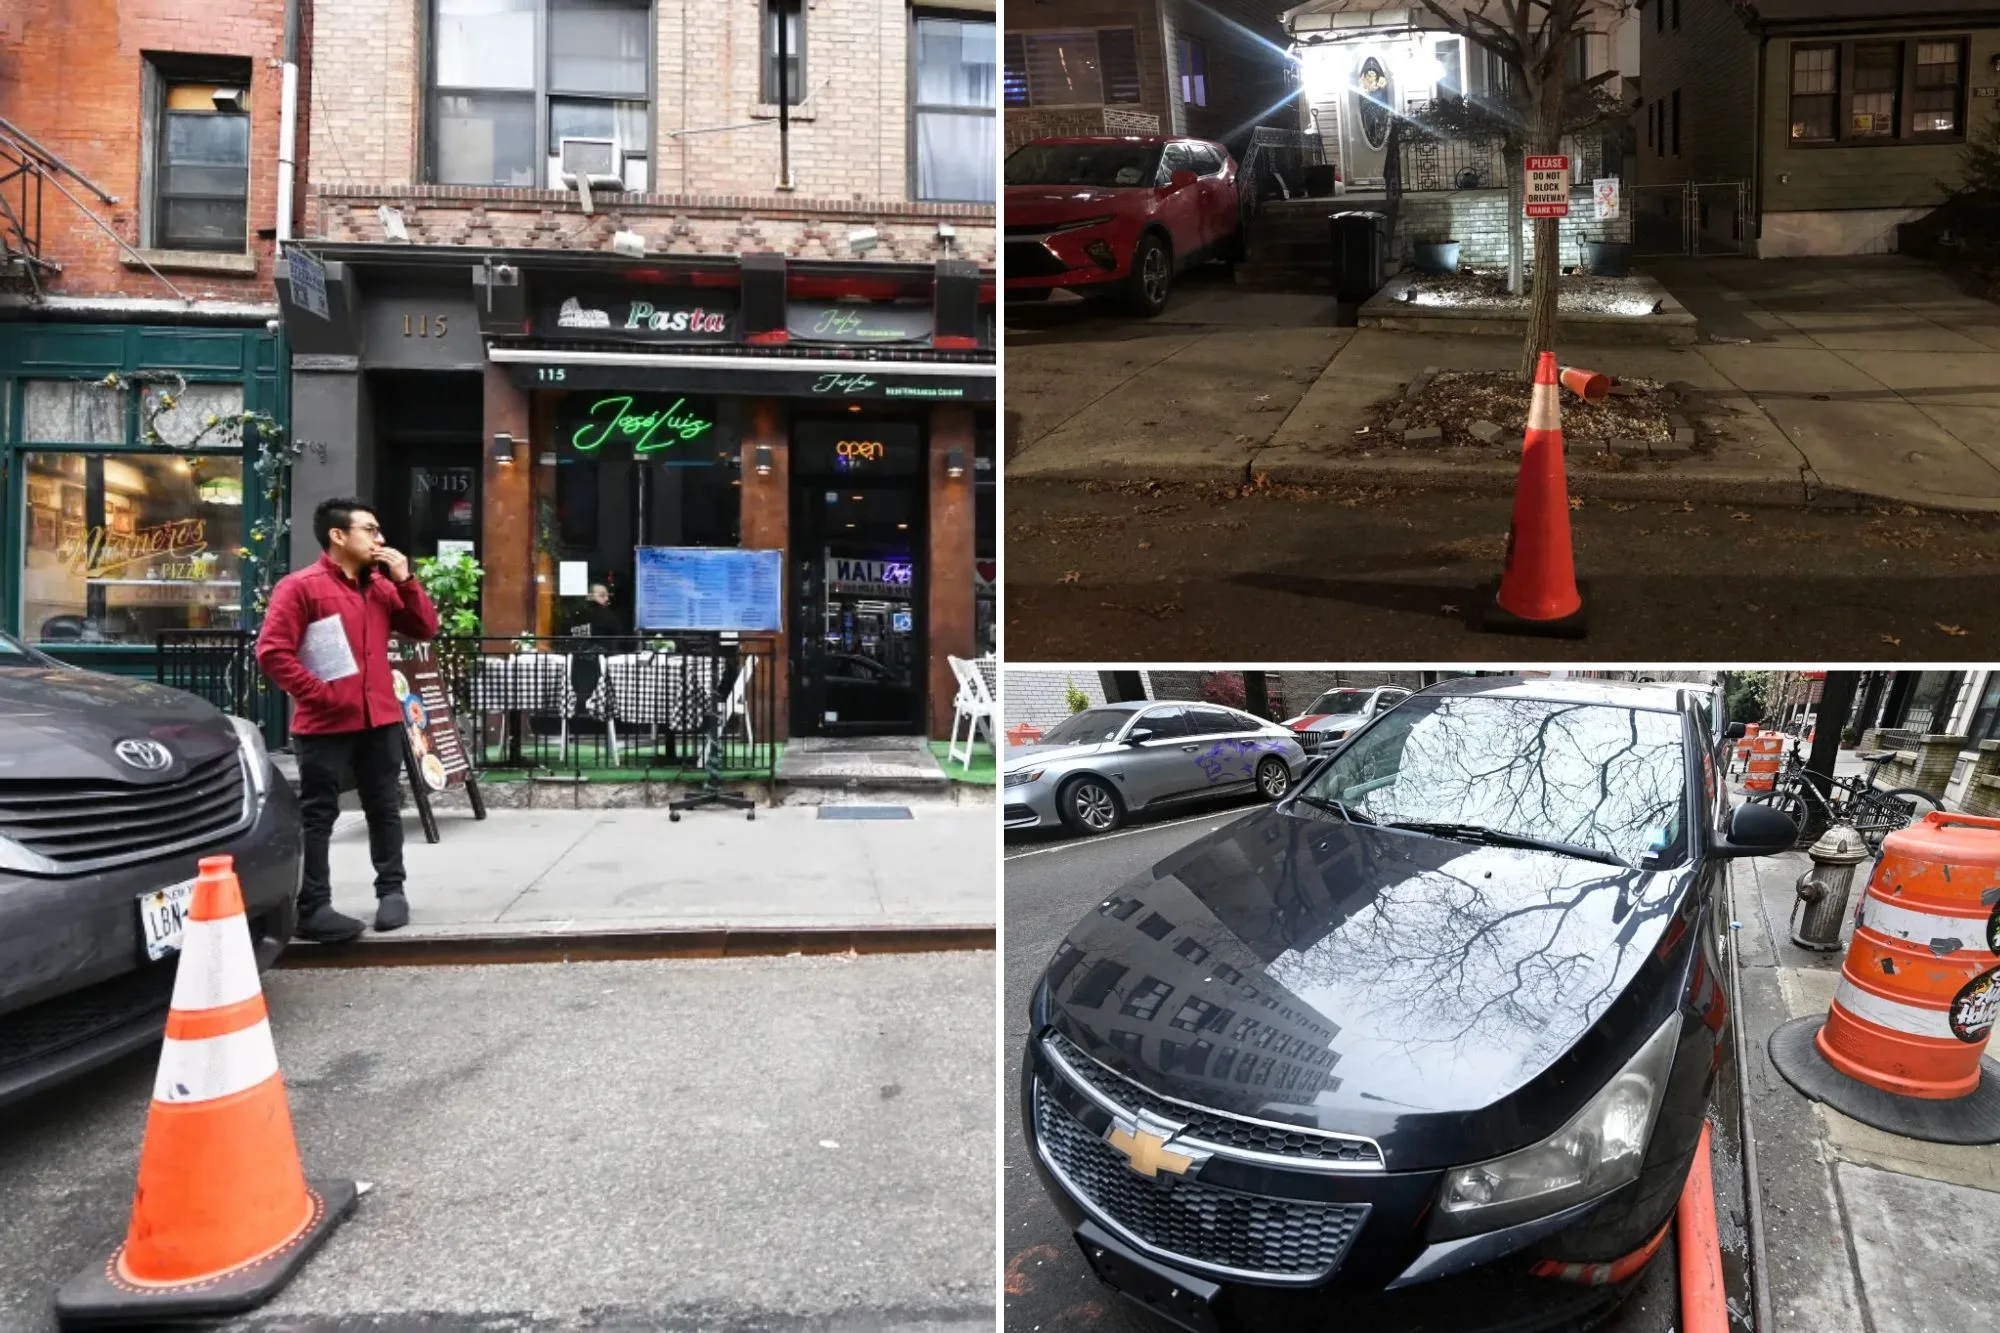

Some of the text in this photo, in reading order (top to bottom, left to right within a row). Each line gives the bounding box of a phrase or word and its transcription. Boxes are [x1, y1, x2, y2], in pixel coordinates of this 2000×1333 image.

[1531, 158, 1563, 168] PLEASE
[1532, 171, 1560, 180] DO NOT
[1534, 183, 1560, 191] BLOCK
[1528, 194, 1566, 202] DRIVEWAY
[1528, 206, 1566, 214] THANK YOU
[624, 301, 725, 332] Pasta
[402, 313, 448, 338] 115
[538, 368, 566, 381] 115
[836, 441, 884, 458] open
[443, 474, 469, 492] 115
